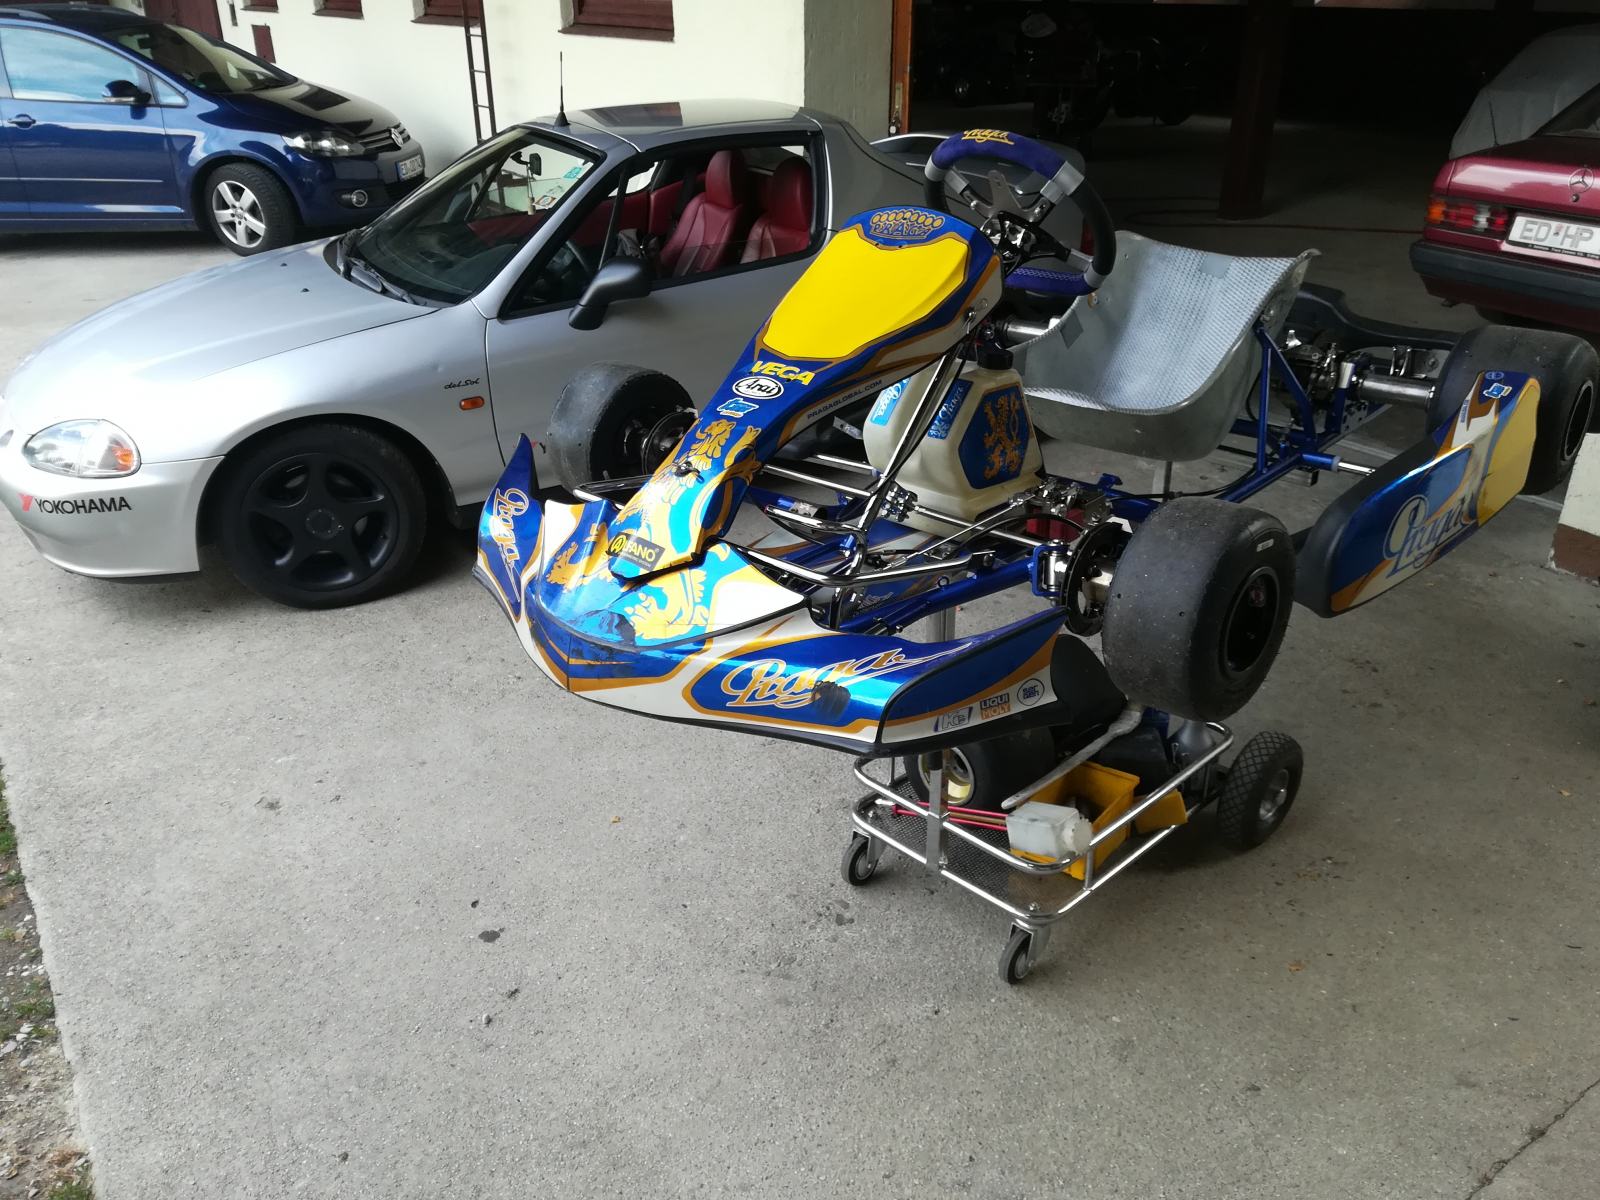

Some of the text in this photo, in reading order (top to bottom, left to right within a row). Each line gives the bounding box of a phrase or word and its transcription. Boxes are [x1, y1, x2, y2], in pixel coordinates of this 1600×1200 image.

[1520, 220, 1551, 242] ED
[751, 361, 816, 386] VEGA
[746, 378, 777, 394] Arai
[807, 379, 882, 419] PRAGAGLOBAL.COM
[34, 496, 132, 514] YOKOHAMA
[981, 693, 1009, 709] LIQUI
[982, 703, 1010, 719] MOLY
